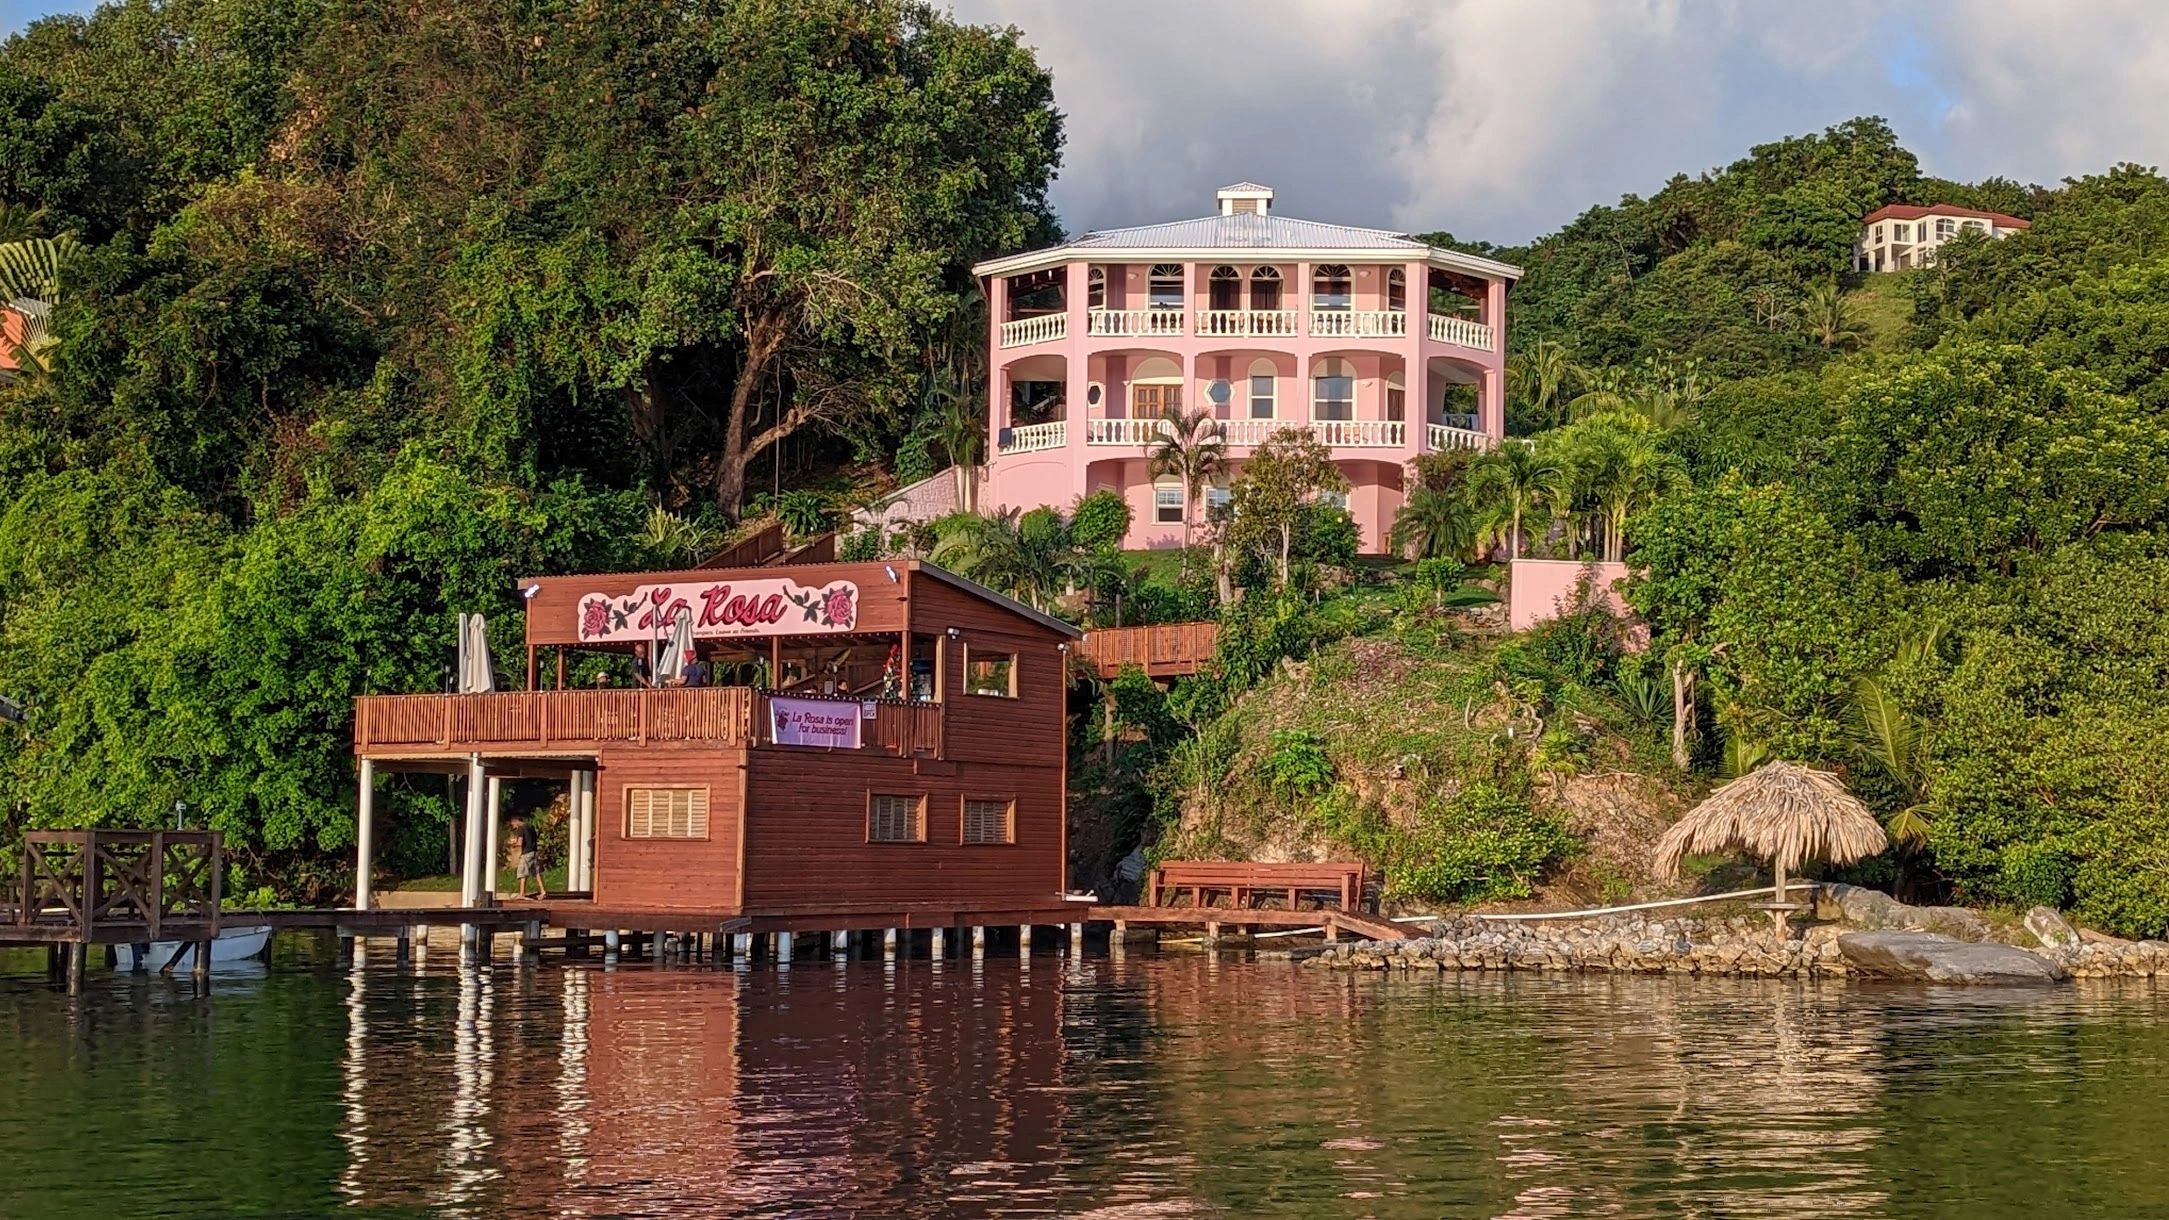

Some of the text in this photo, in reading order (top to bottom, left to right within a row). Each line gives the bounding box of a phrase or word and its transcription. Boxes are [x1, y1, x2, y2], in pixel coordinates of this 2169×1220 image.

[697, 584, 788, 629] Rosa
[792, 712, 854, 727] La Rosa is open
[799, 723, 810, 733] for
